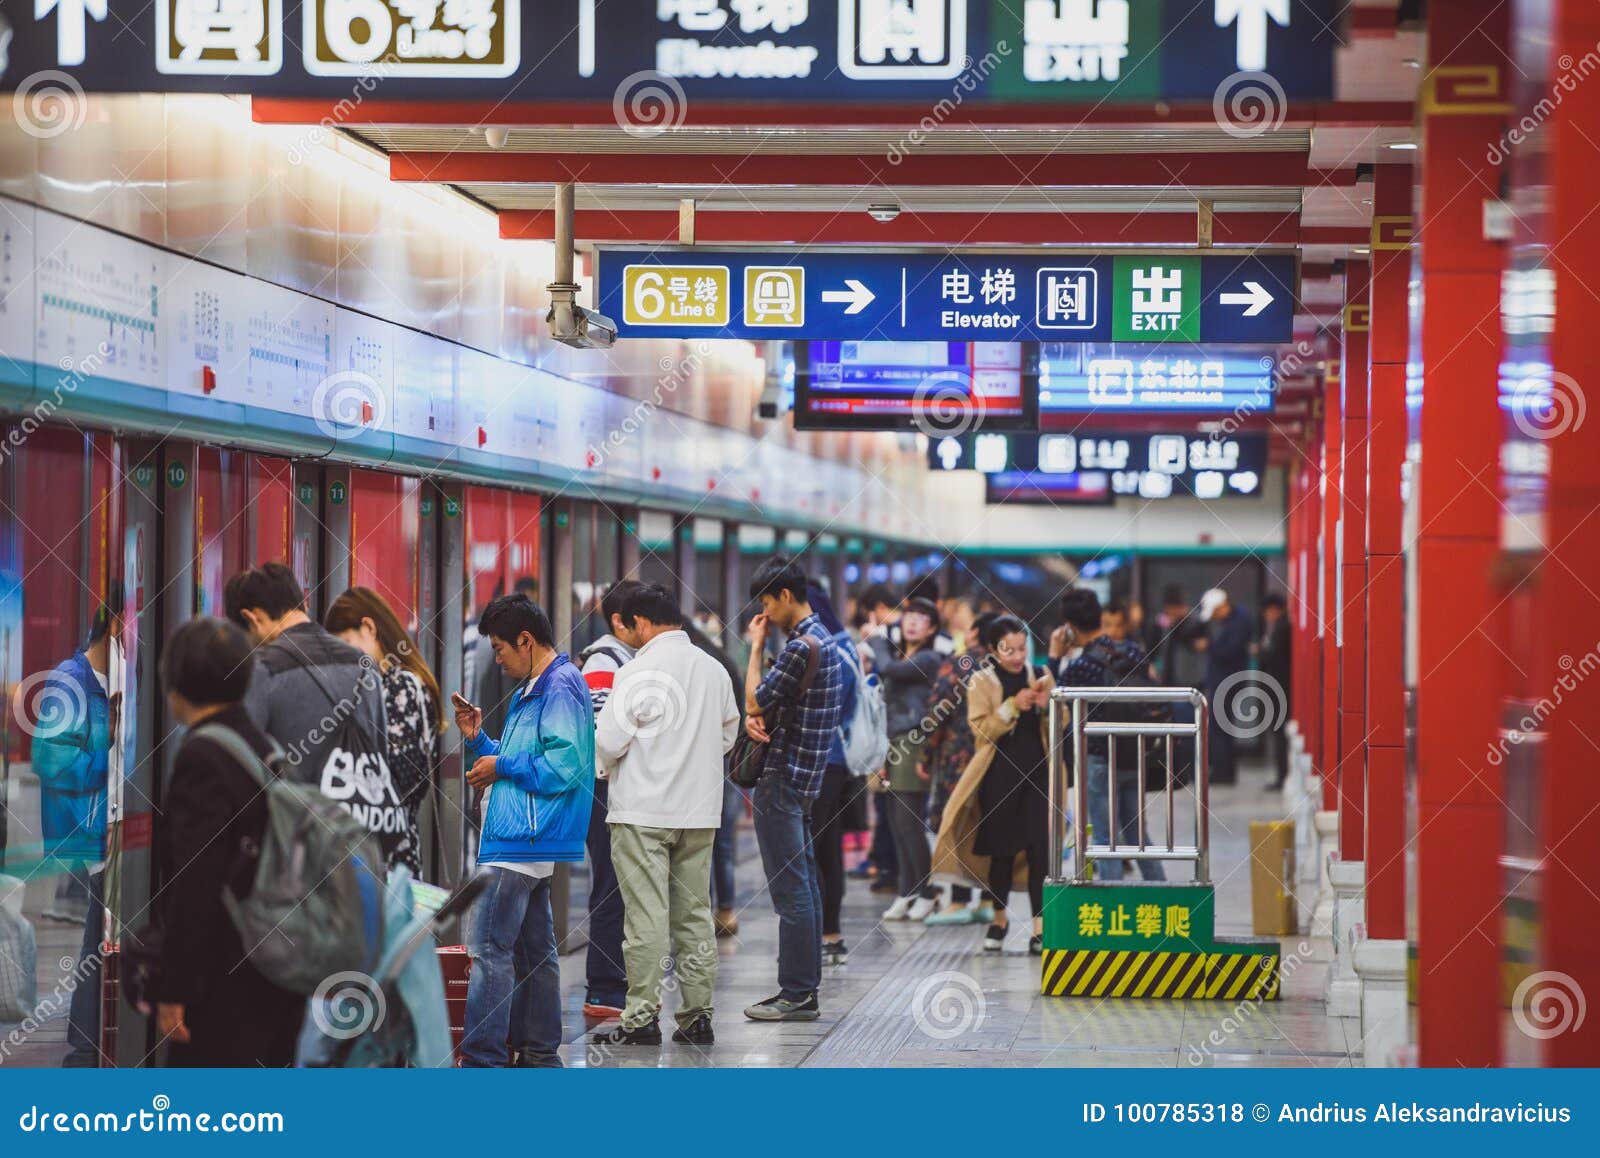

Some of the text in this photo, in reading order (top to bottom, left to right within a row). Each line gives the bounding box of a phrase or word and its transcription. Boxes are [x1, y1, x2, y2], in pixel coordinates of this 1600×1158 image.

[1023, 44, 1129, 81] EXIT
[942, 268, 1016, 305] 电梯
[1132, 267, 1182, 313] 出
[671, 302, 716, 317] Line 6
[941, 311, 1021, 328] Elevator
[1131, 314, 1181, 331] EXIT
[168, 468, 185, 481] 10
[331, 487, 343, 499] 11
[1078, 903, 1190, 938] 禁止攀爬
